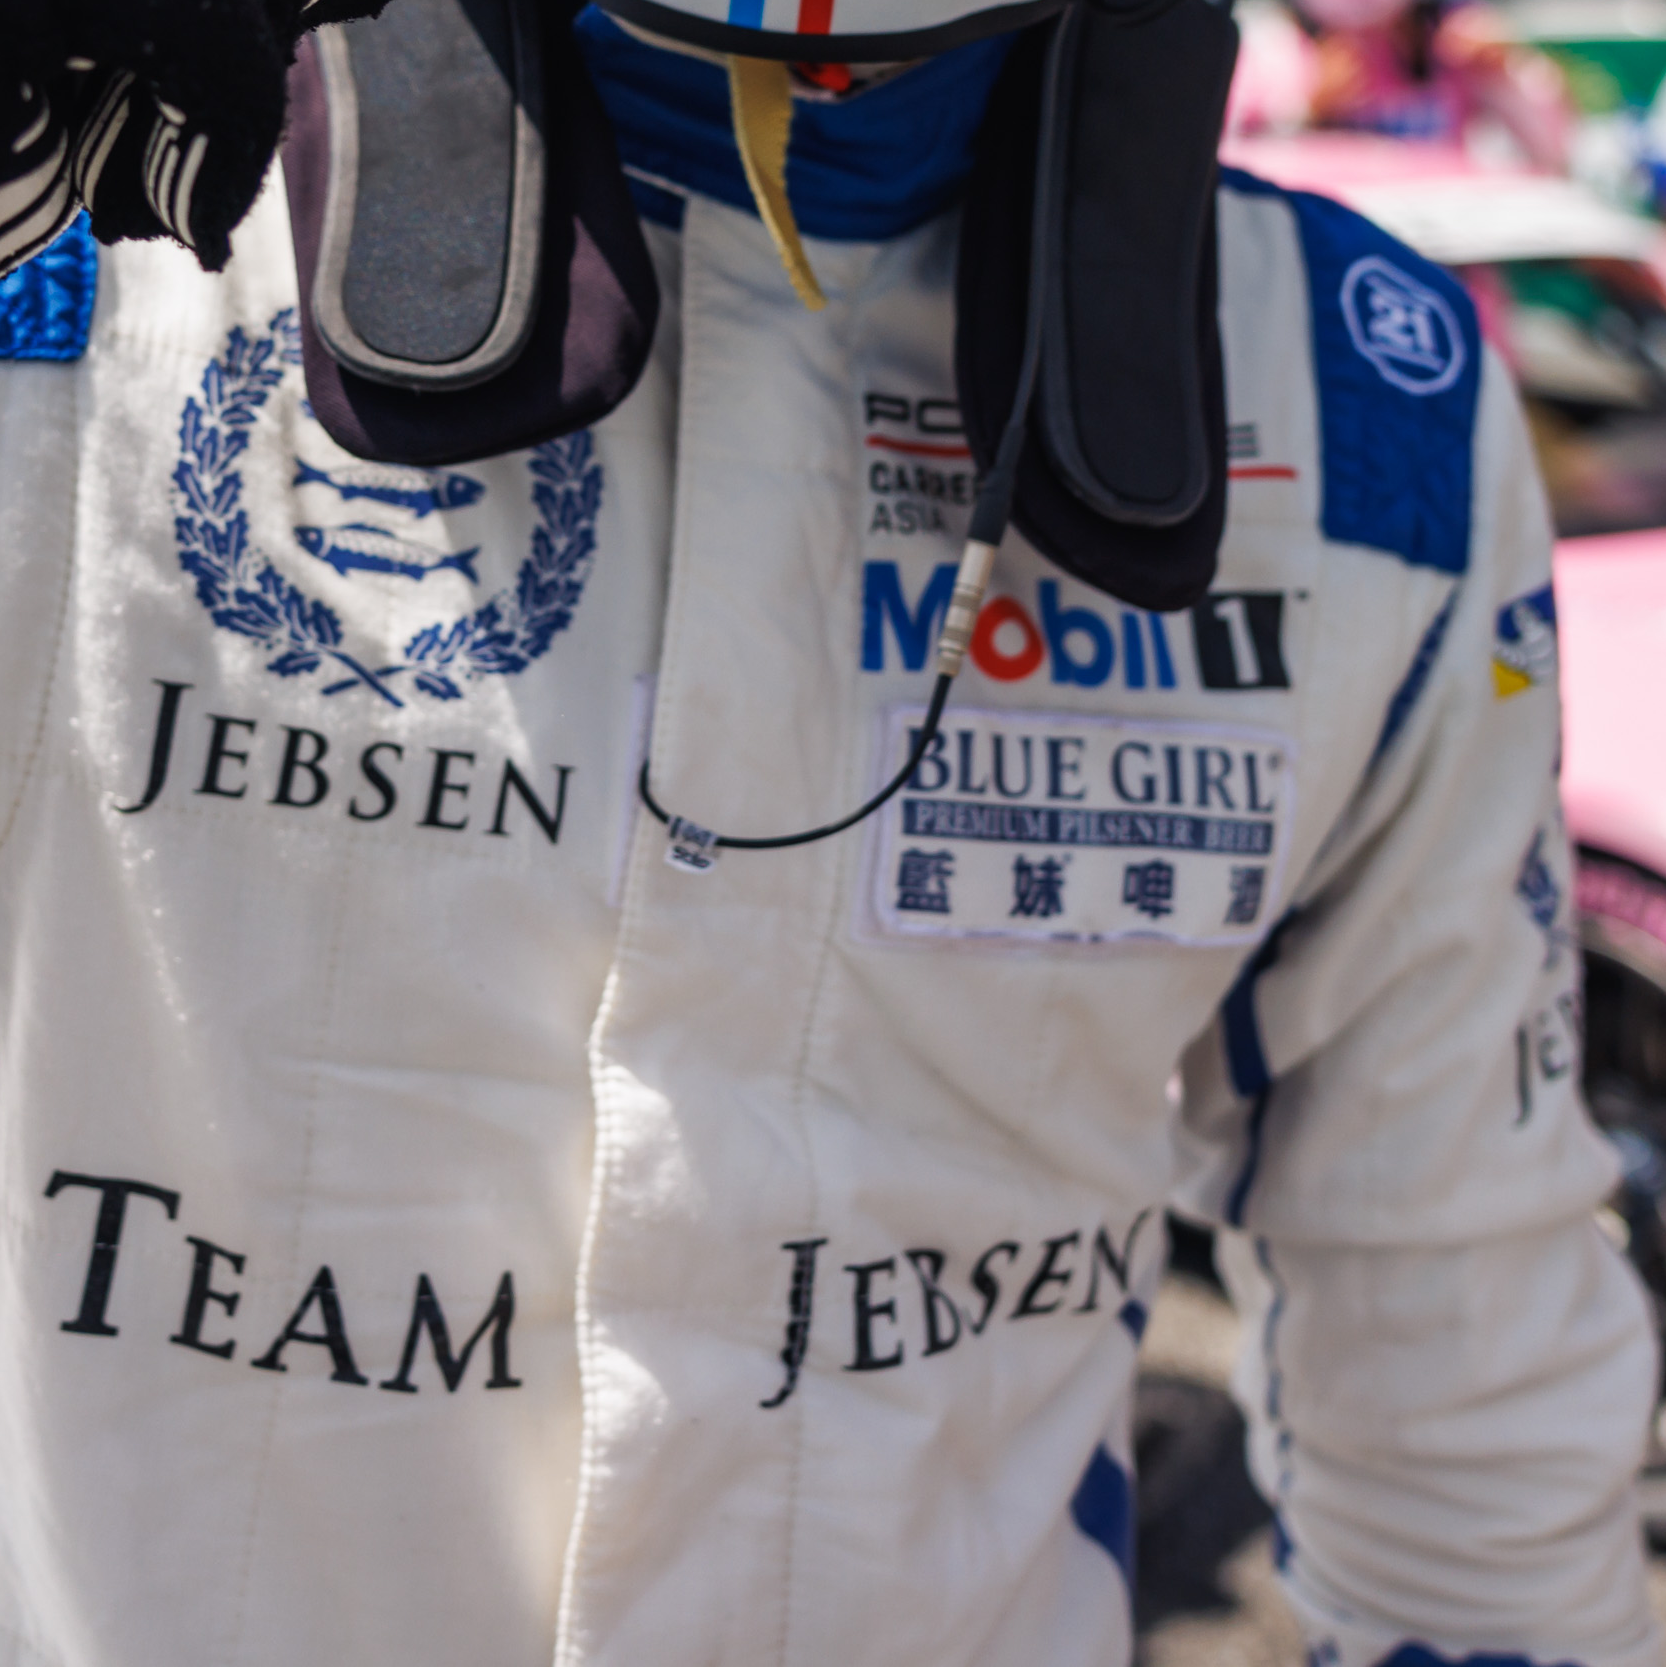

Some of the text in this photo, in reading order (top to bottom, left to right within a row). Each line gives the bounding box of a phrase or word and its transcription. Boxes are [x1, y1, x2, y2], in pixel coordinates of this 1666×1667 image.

[860, 560, 1177, 690] Mobil
[114, 679, 576, 845] JEBSEN
[905, 727, 1275, 813] BLUE GIRL
[915, 803, 1269, 852] PREMIUM PILSENER BEER
[43, 1170, 522, 1393] TEAM
[759, 1207, 1152, 1409] JEBSEN
